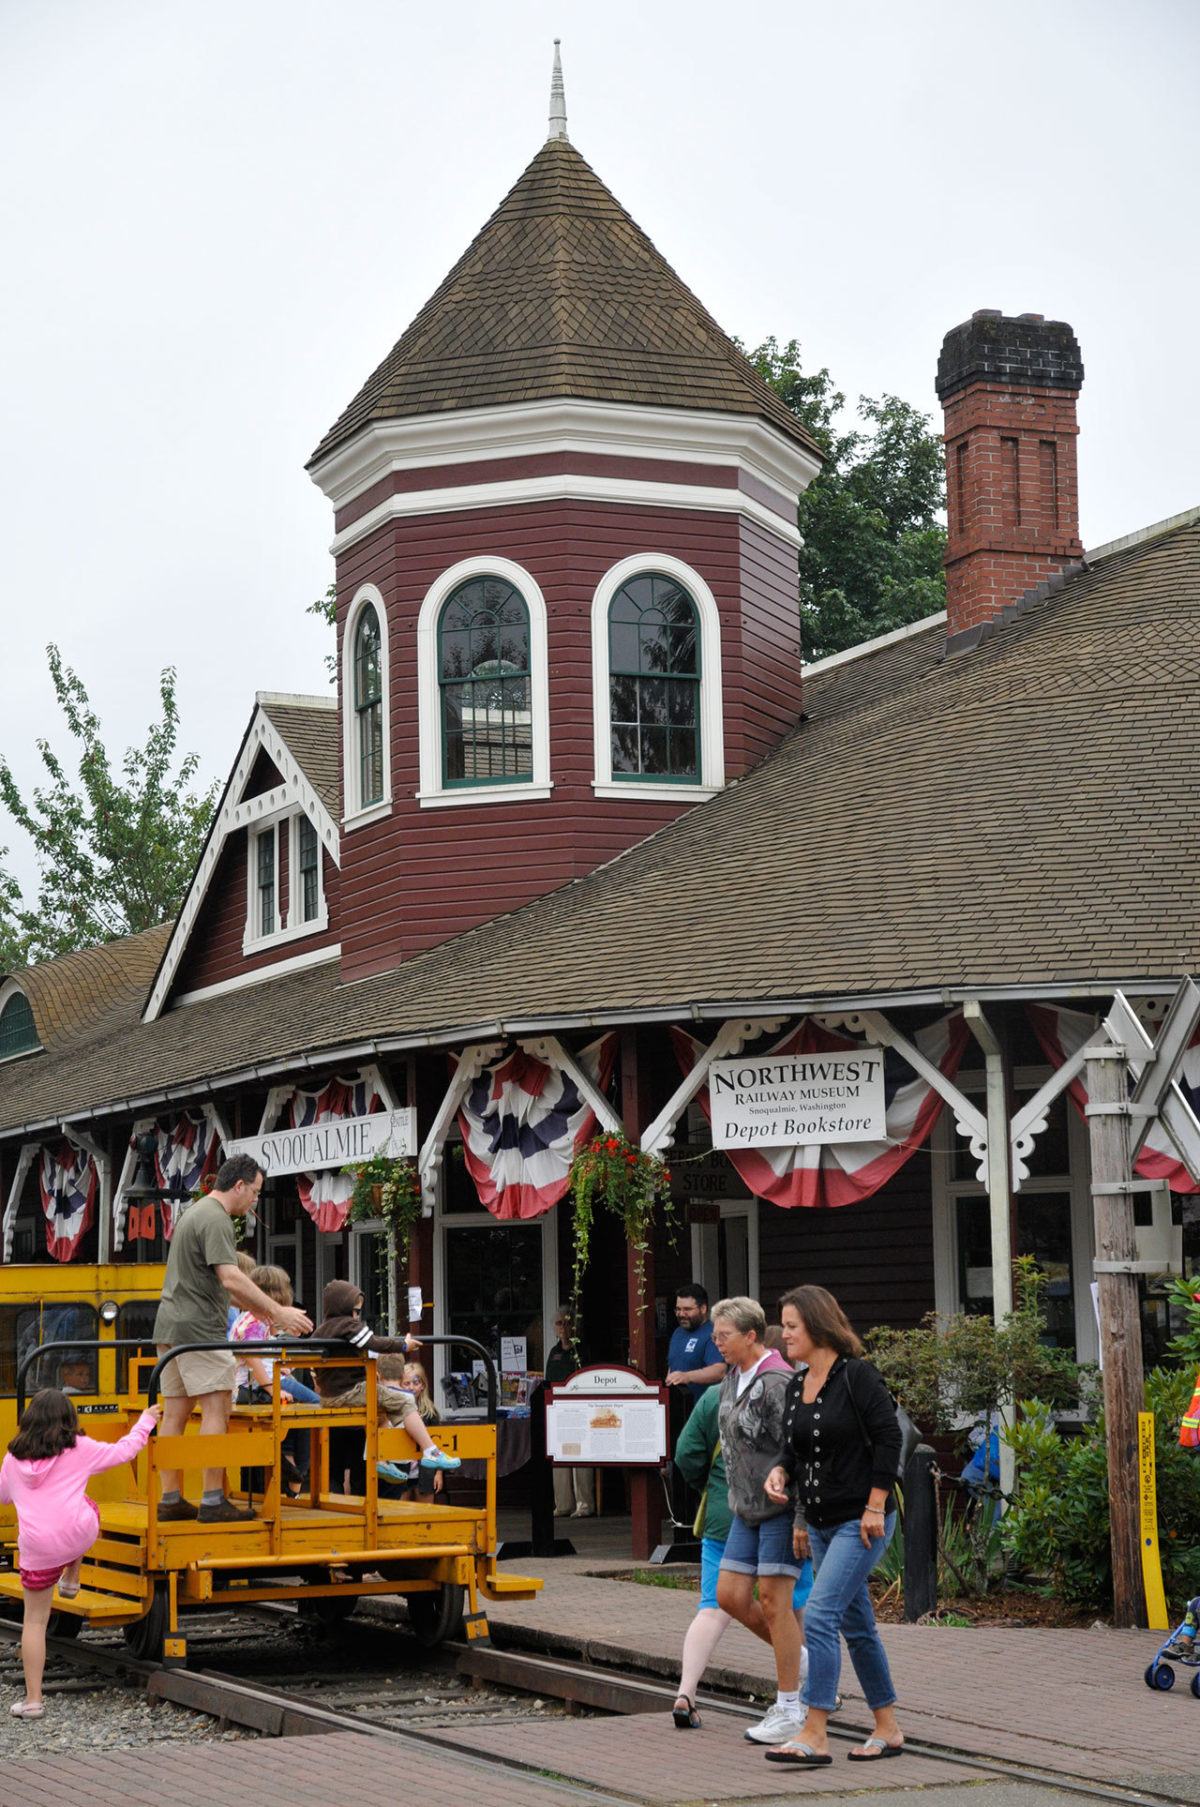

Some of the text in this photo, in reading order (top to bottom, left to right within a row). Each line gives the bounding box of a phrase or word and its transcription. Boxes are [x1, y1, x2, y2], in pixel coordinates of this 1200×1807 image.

[713, 1061, 880, 1094] NORTHWEST
[735, 1086, 860, 1105] RAILWAY MUSEUM
[749, 1103, 847, 1115] Snoqualmie, Washington
[725, 1117, 872, 1142] Depot Bookstore
[683, 1174, 728, 1191] STORE
[594, 1376, 617, 1386] Depot
